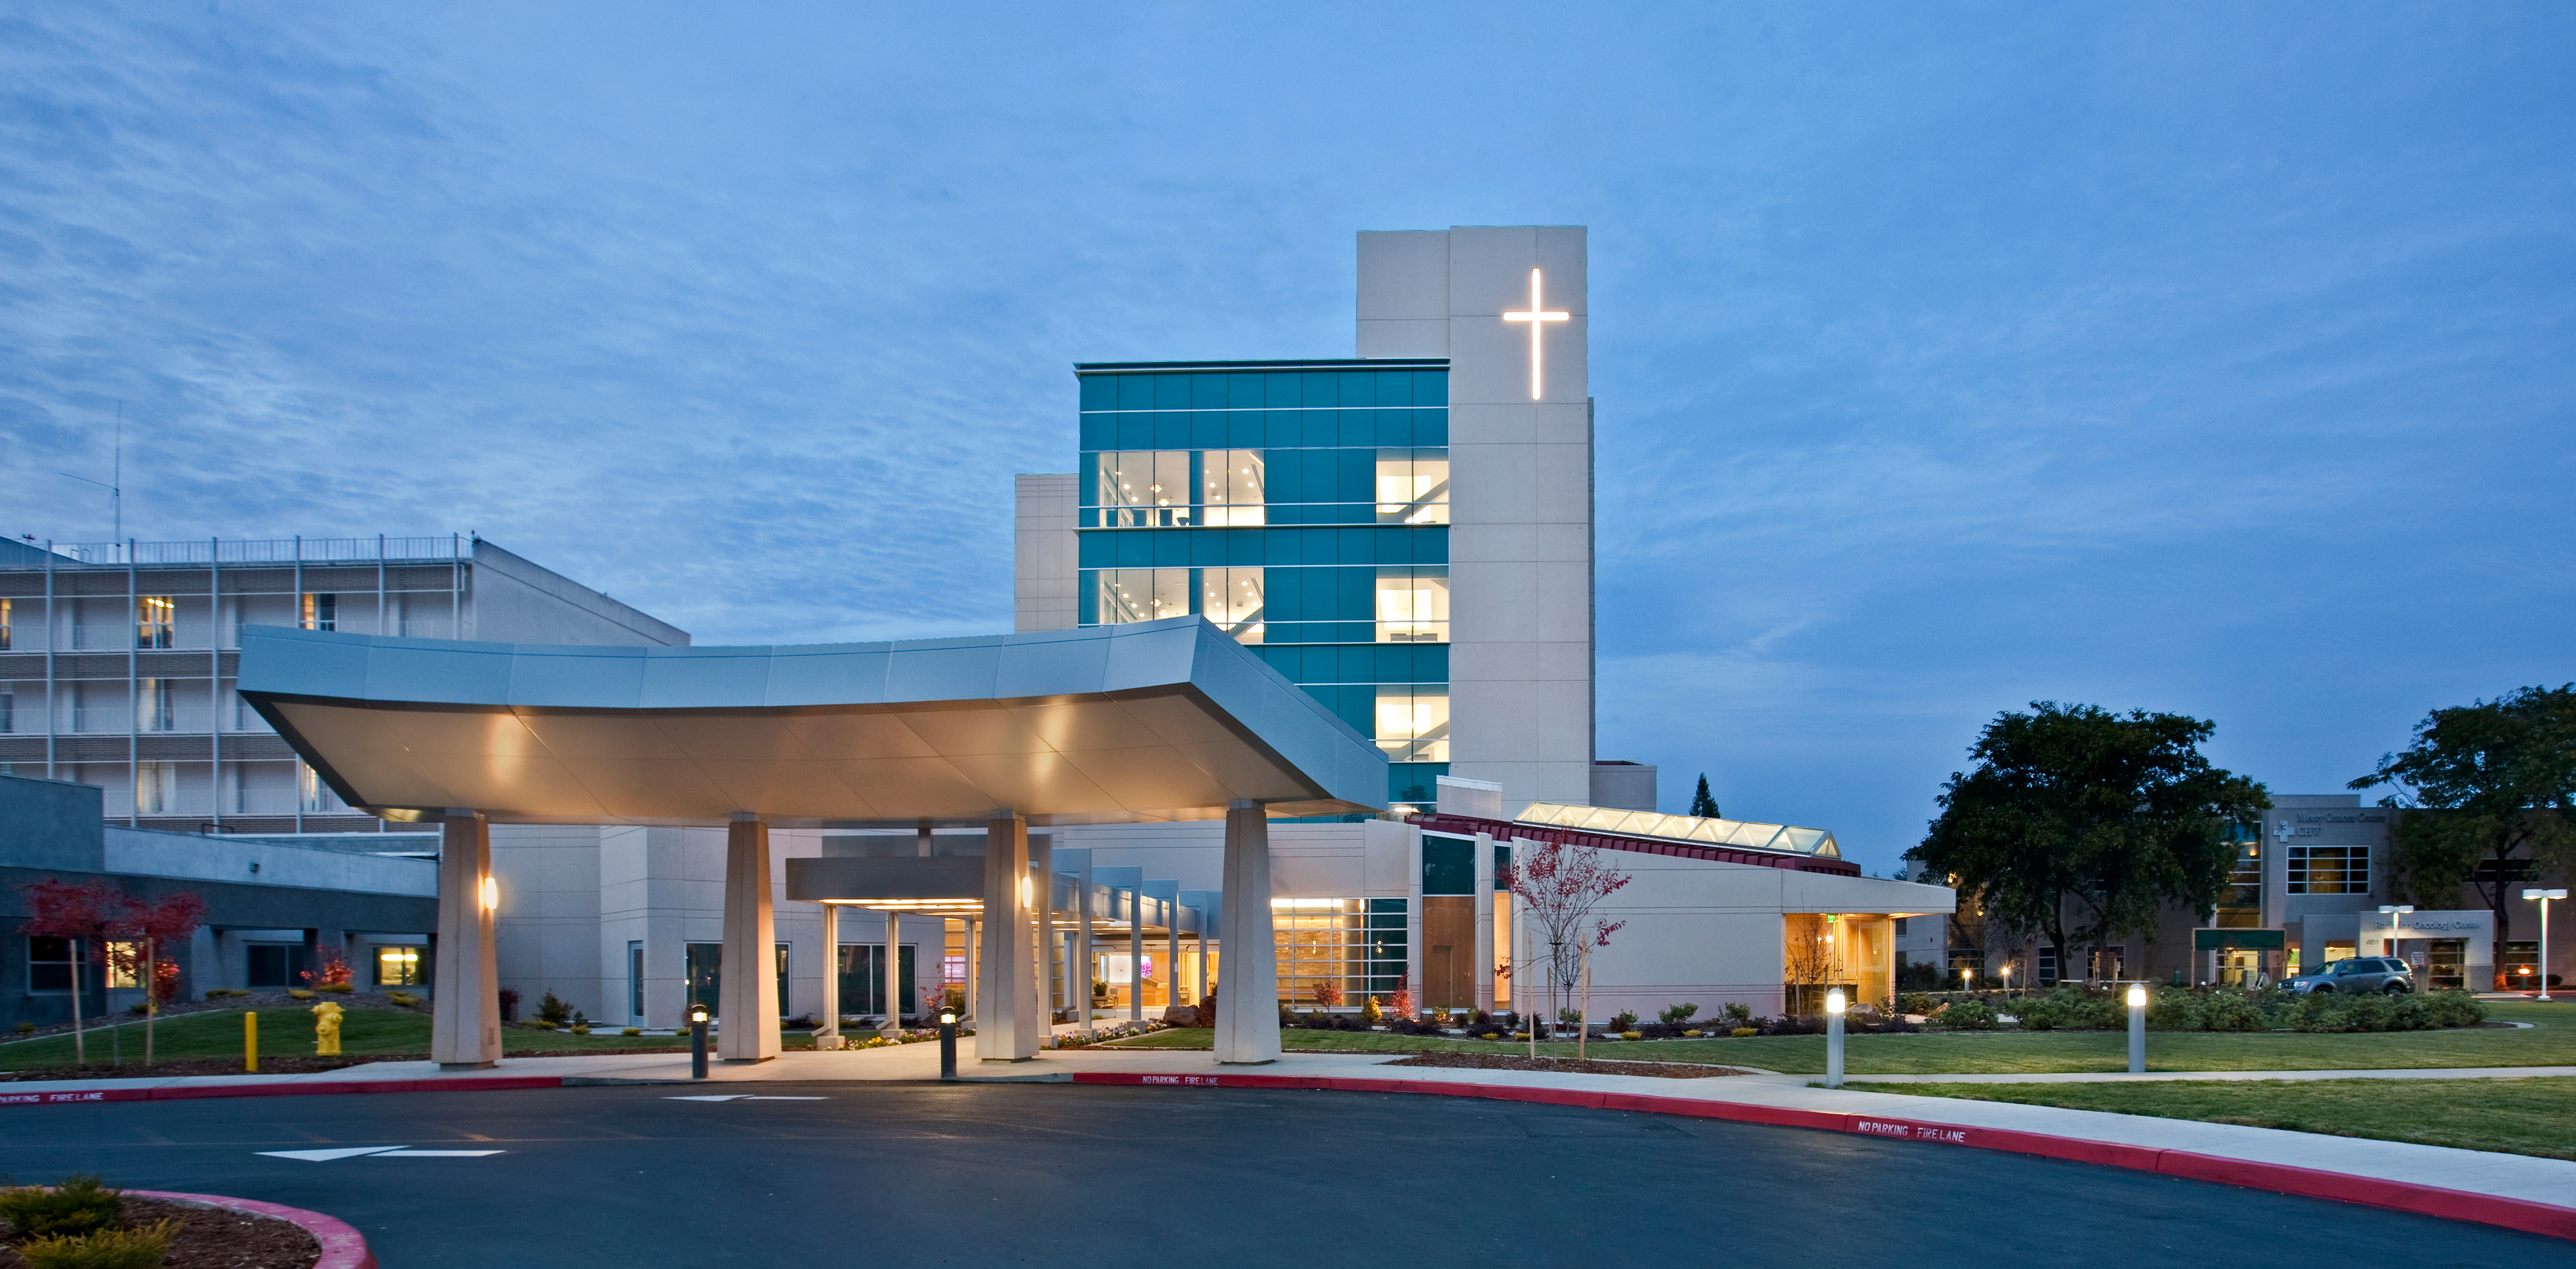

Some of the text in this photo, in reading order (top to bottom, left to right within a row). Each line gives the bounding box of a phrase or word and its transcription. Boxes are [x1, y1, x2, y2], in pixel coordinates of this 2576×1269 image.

[2296, 813, 2323, 825] Mercy
[2325, 813, 2355, 823] Cancer
[2297, 827, 2322, 837] CHW
[2413, 921, 2450, 930] Oncology
[2454, 920, 2480, 928] Center
[1143, 1076, 1152, 1084] NO
[1152, 1076, 1179, 1084] PARKING
[1201, 1077, 1218, 1085] LANE
[49, 1093, 74, 1102] FIRE
[75, 1093, 104, 1101] LANE
[1858, 1121, 1966, 1142] NO PARKING FIRE LANE
